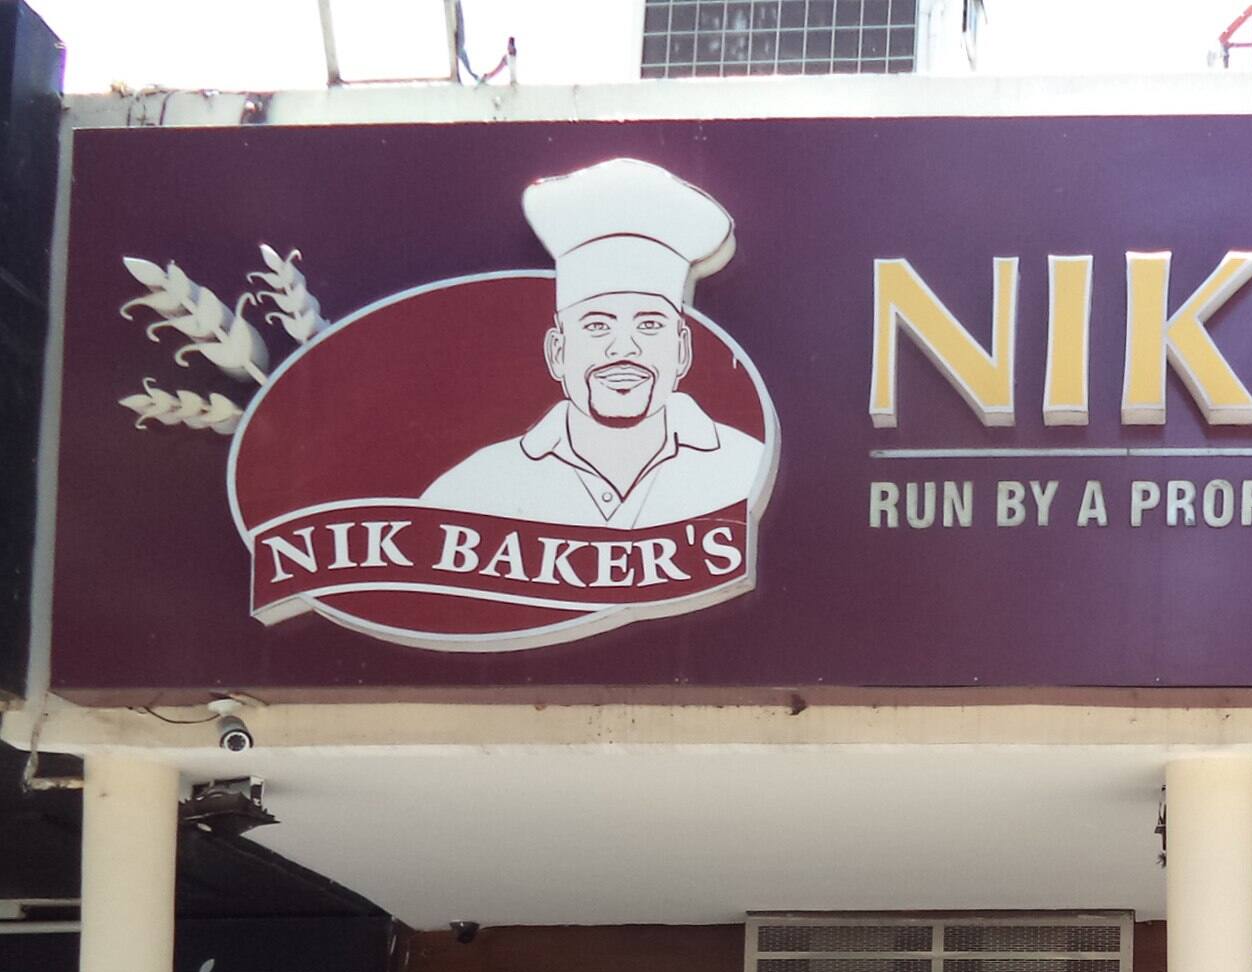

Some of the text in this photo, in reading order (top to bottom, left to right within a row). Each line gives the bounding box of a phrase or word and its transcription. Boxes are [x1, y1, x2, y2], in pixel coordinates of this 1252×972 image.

[868, 480, 974, 528] RUN
[995, 480, 1060, 527] BY
[1076, 480, 1108, 527] A
[261, 520, 744, 588] NIK BAKER'S
